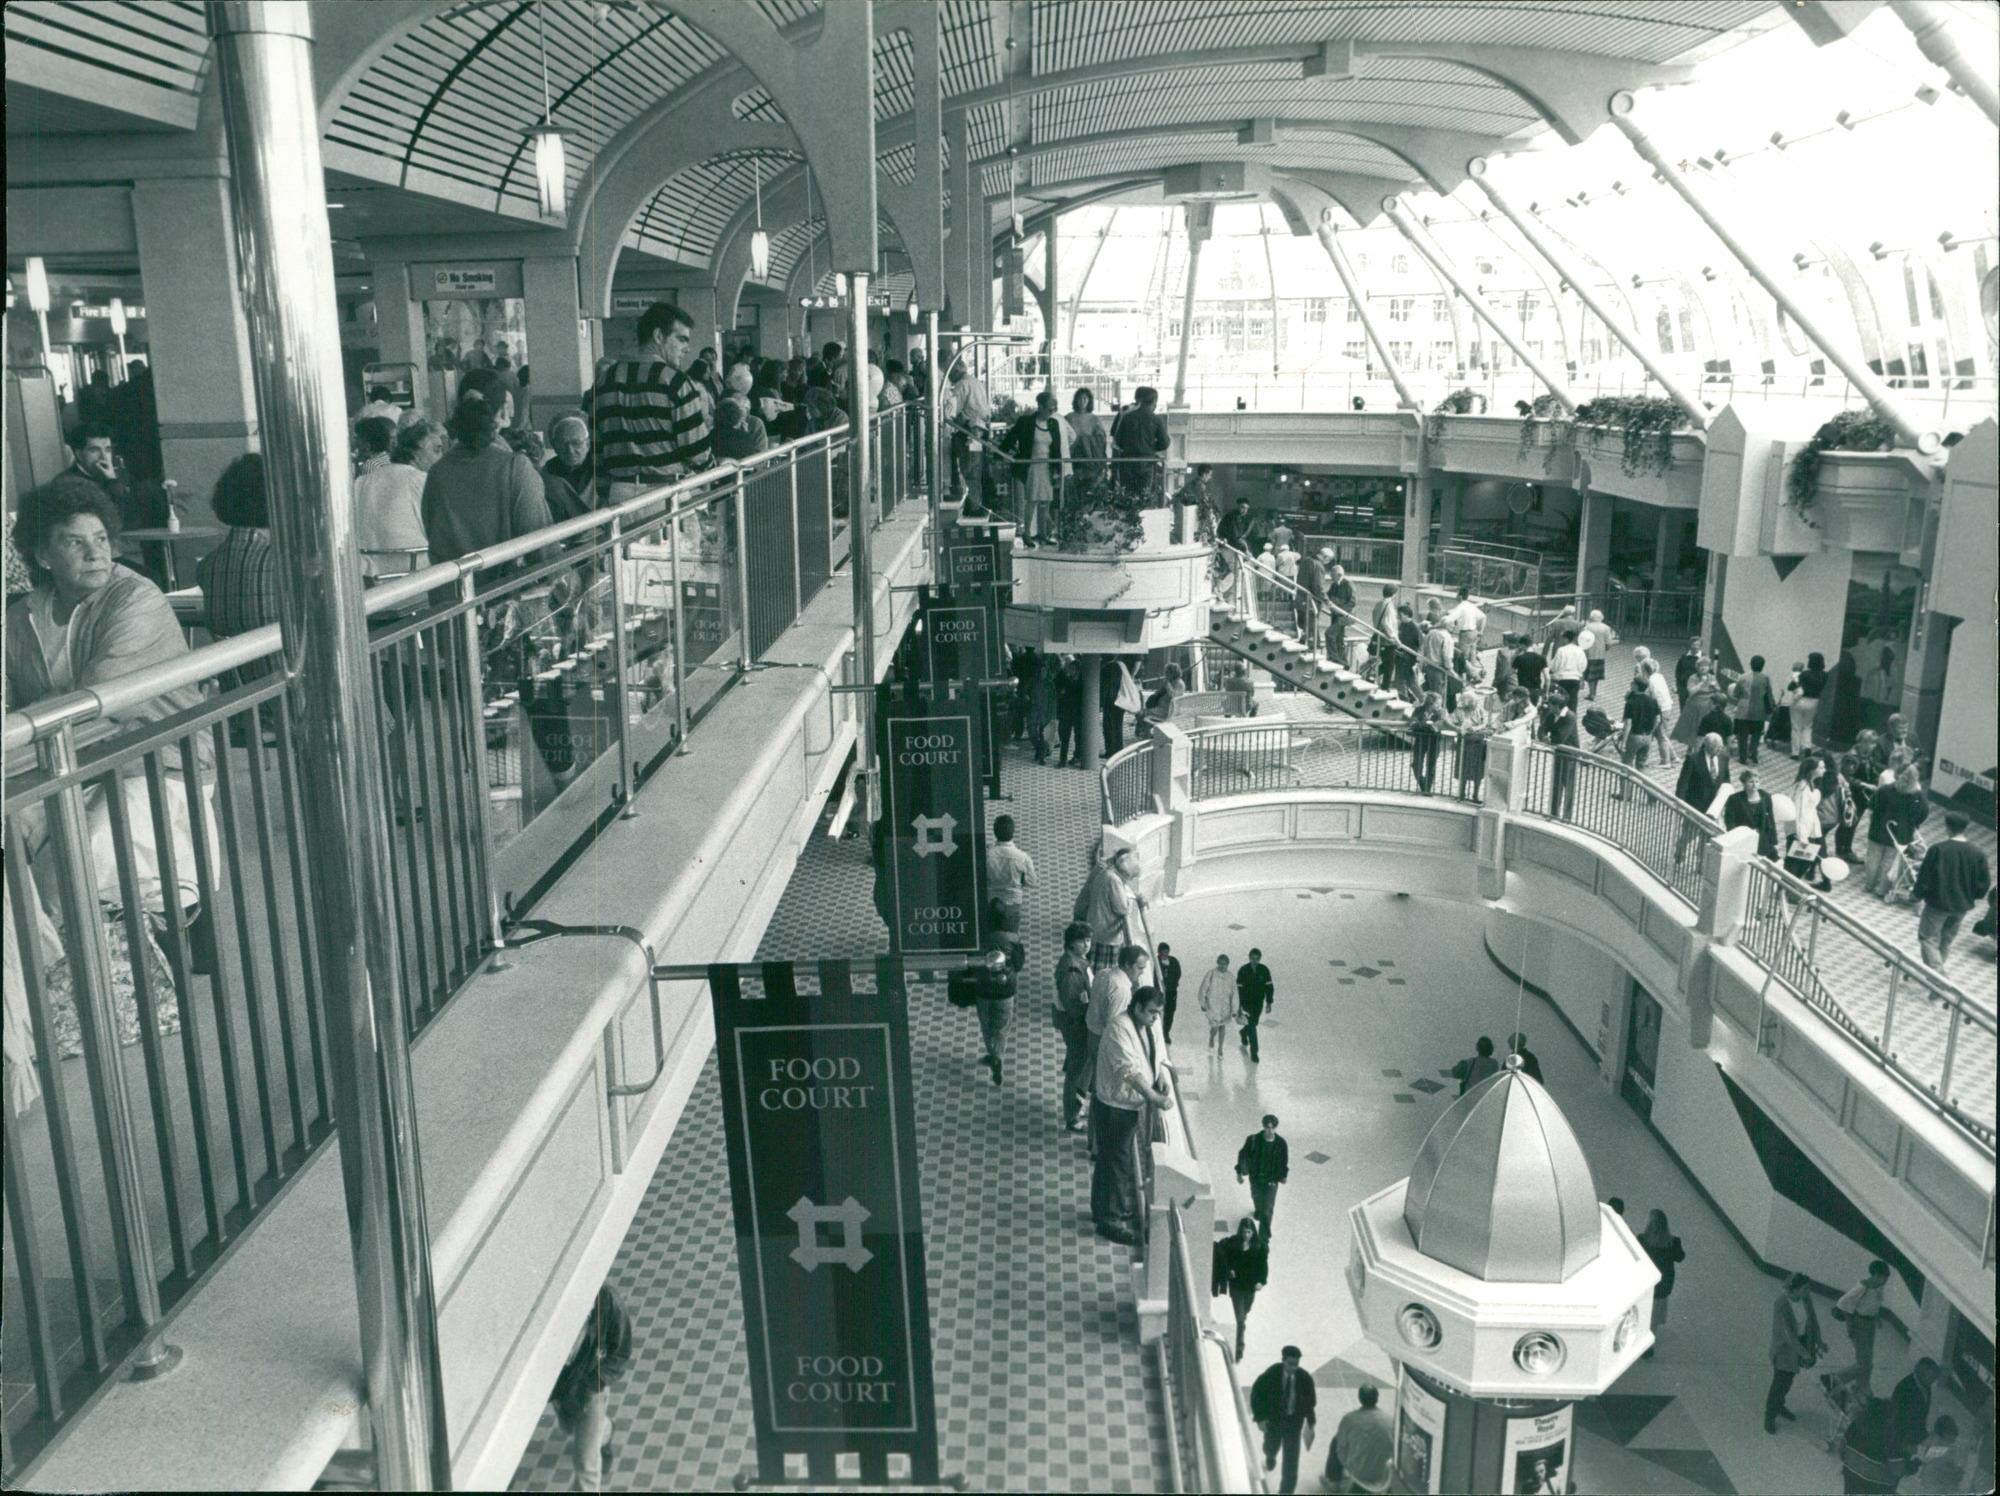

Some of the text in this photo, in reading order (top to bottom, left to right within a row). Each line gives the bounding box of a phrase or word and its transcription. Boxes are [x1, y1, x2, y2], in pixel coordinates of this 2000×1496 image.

[449, 272, 493, 284] No Smoking
[867, 295, 888, 306] Exit
[959, 554, 986, 563] FOOD
[956, 563, 989, 572] COURT
[939, 620, 976, 632] FOOD
[935, 631, 979, 643] COURT
[904, 735, 954, 749] FOOD
[900, 750, 961, 766] COURT
[914, 906, 963, 920] FOOD
[908, 921, 969, 935] COURT
[768, 1057, 860, 1081] FOOD
[760, 1085, 875, 1111] COURT
[796, 1355, 884, 1377] FOOD
[787, 1381, 897, 1403] COURT
